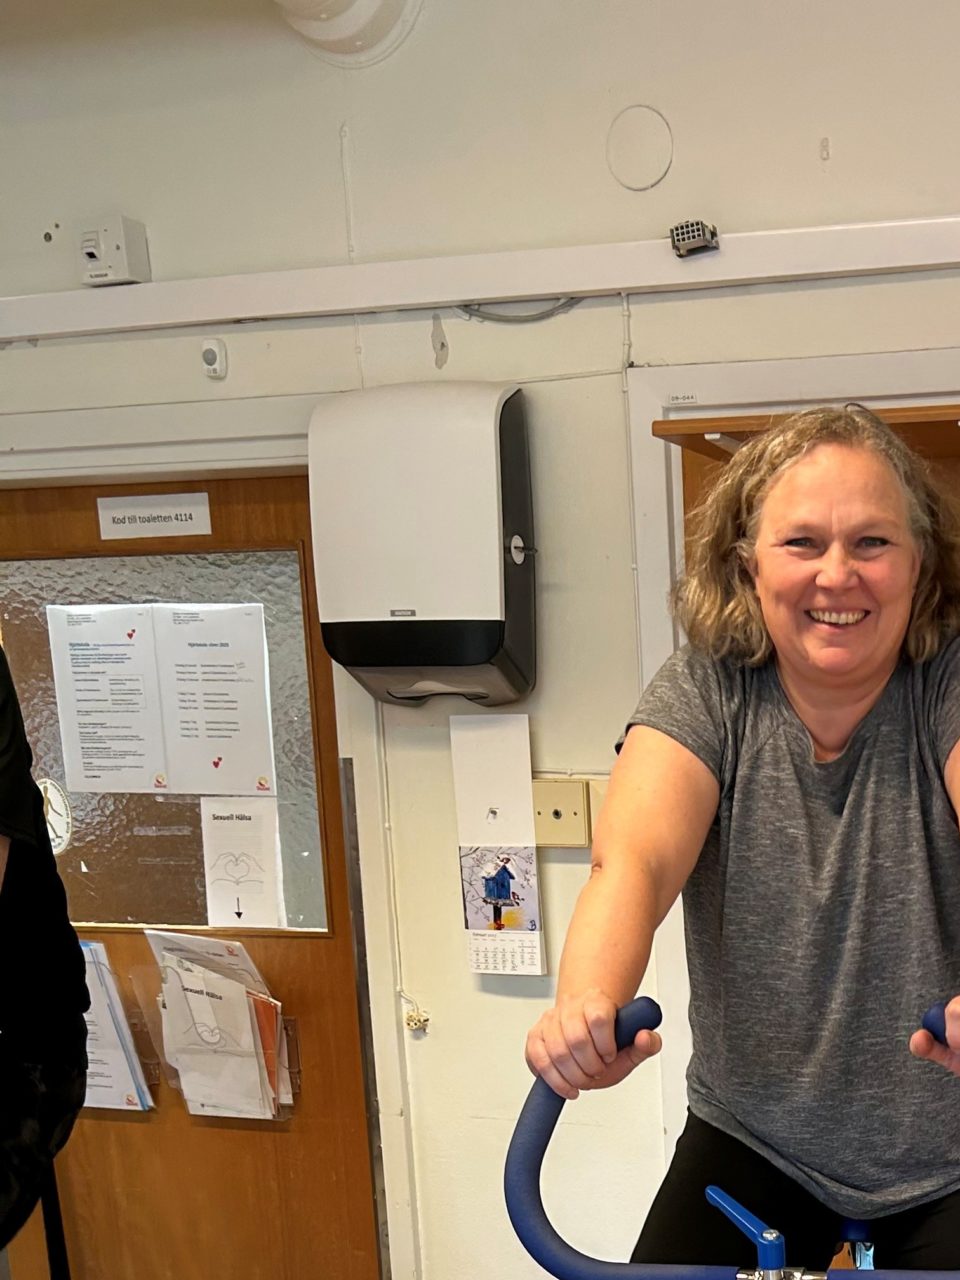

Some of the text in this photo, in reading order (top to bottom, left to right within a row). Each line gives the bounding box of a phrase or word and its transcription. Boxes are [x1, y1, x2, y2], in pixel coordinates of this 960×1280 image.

[112, 513, 193, 525] Kod till toaletten 4114
